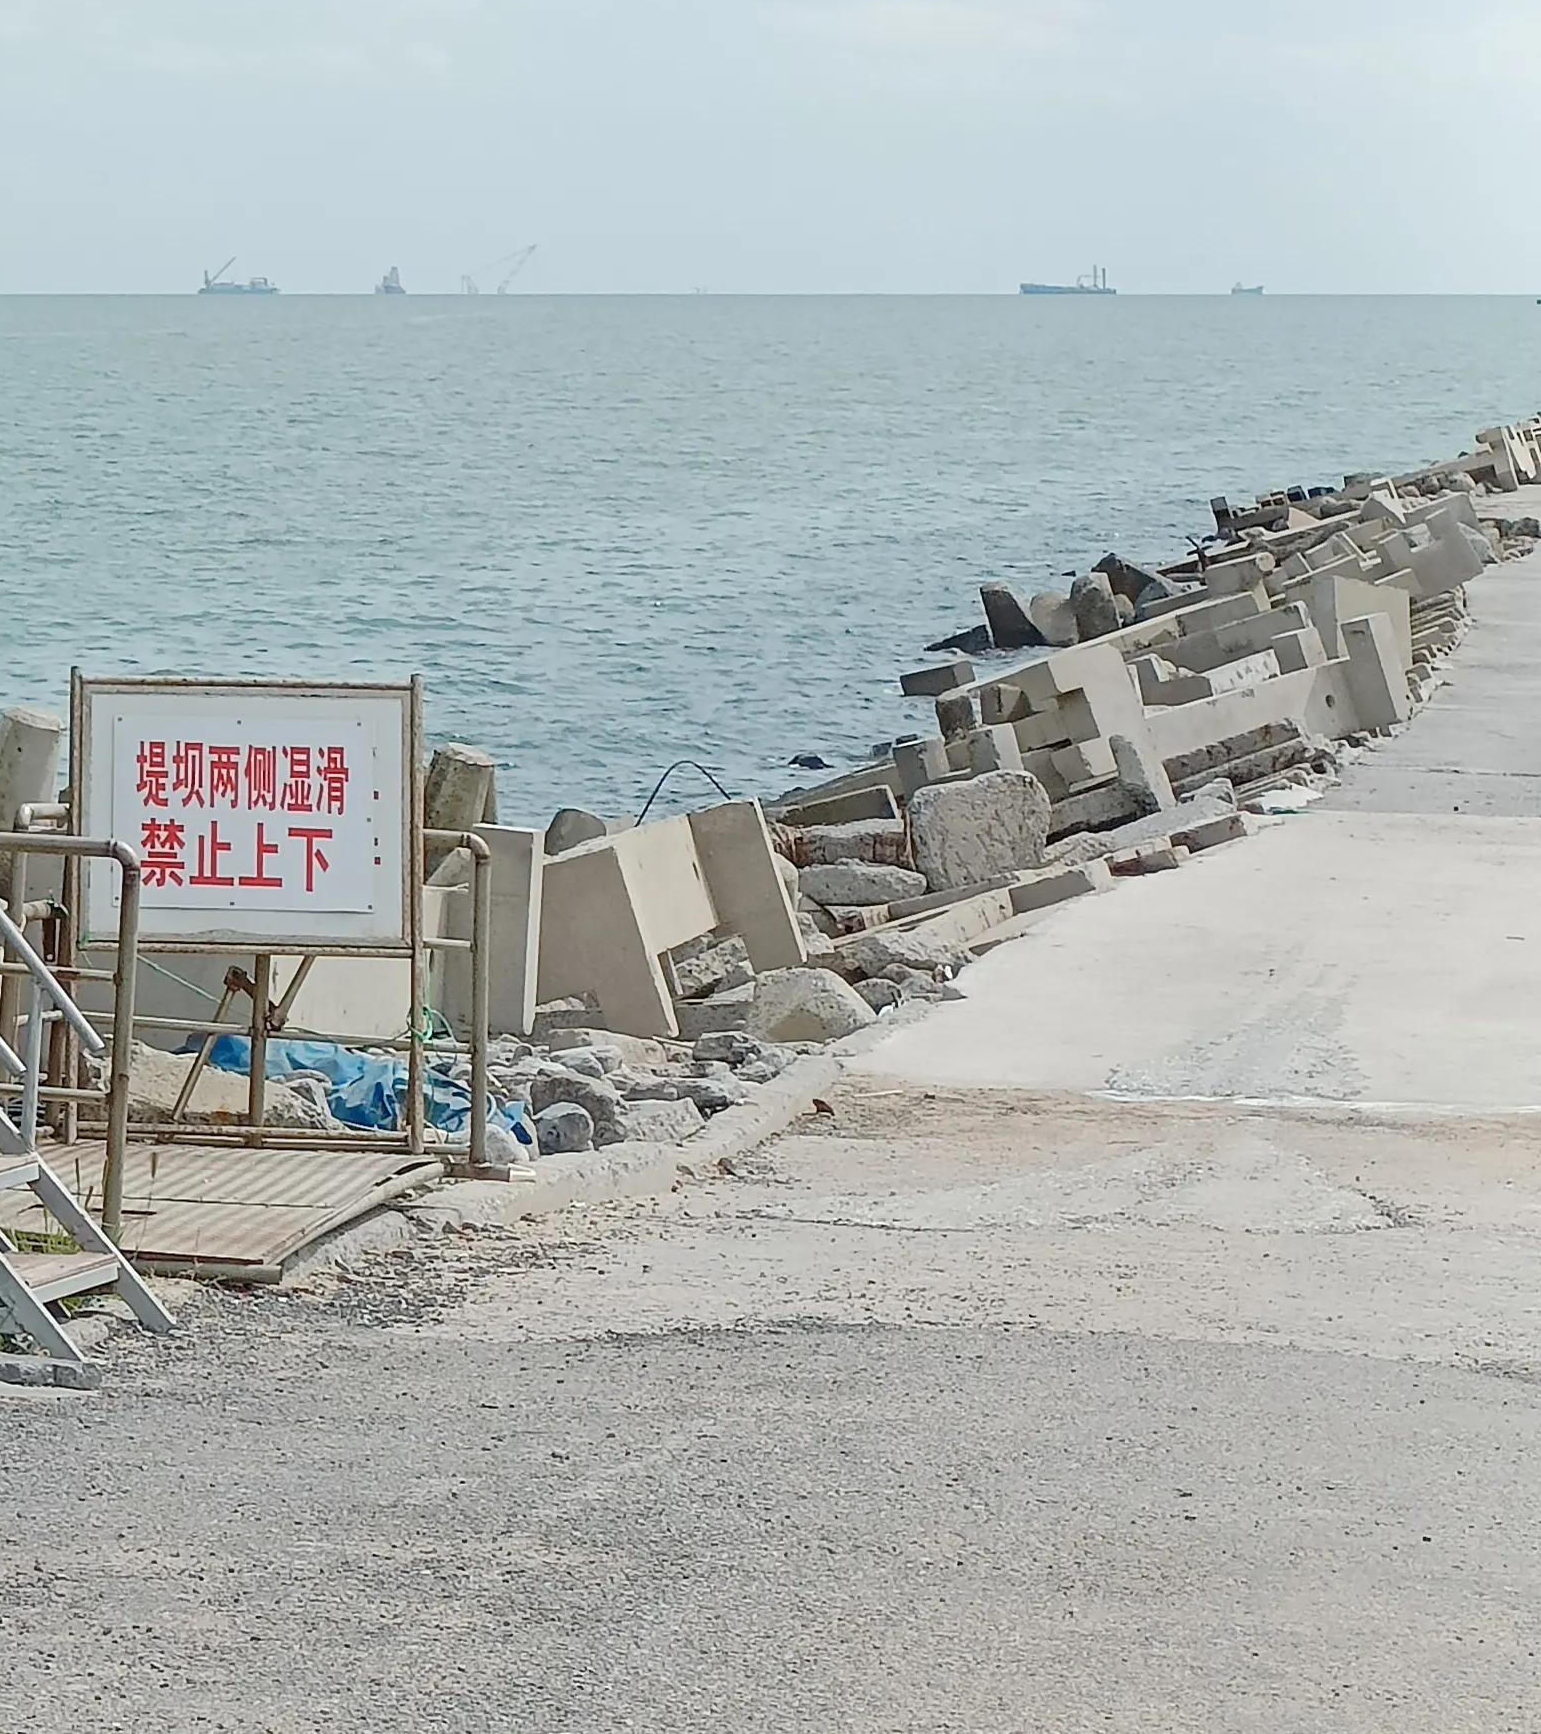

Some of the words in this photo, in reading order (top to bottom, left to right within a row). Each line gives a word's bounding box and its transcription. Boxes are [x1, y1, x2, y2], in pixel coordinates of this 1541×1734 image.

[136, 740, 349, 815] 堤坝两侧湿滑
[140, 817, 333, 892] 禁止上下
